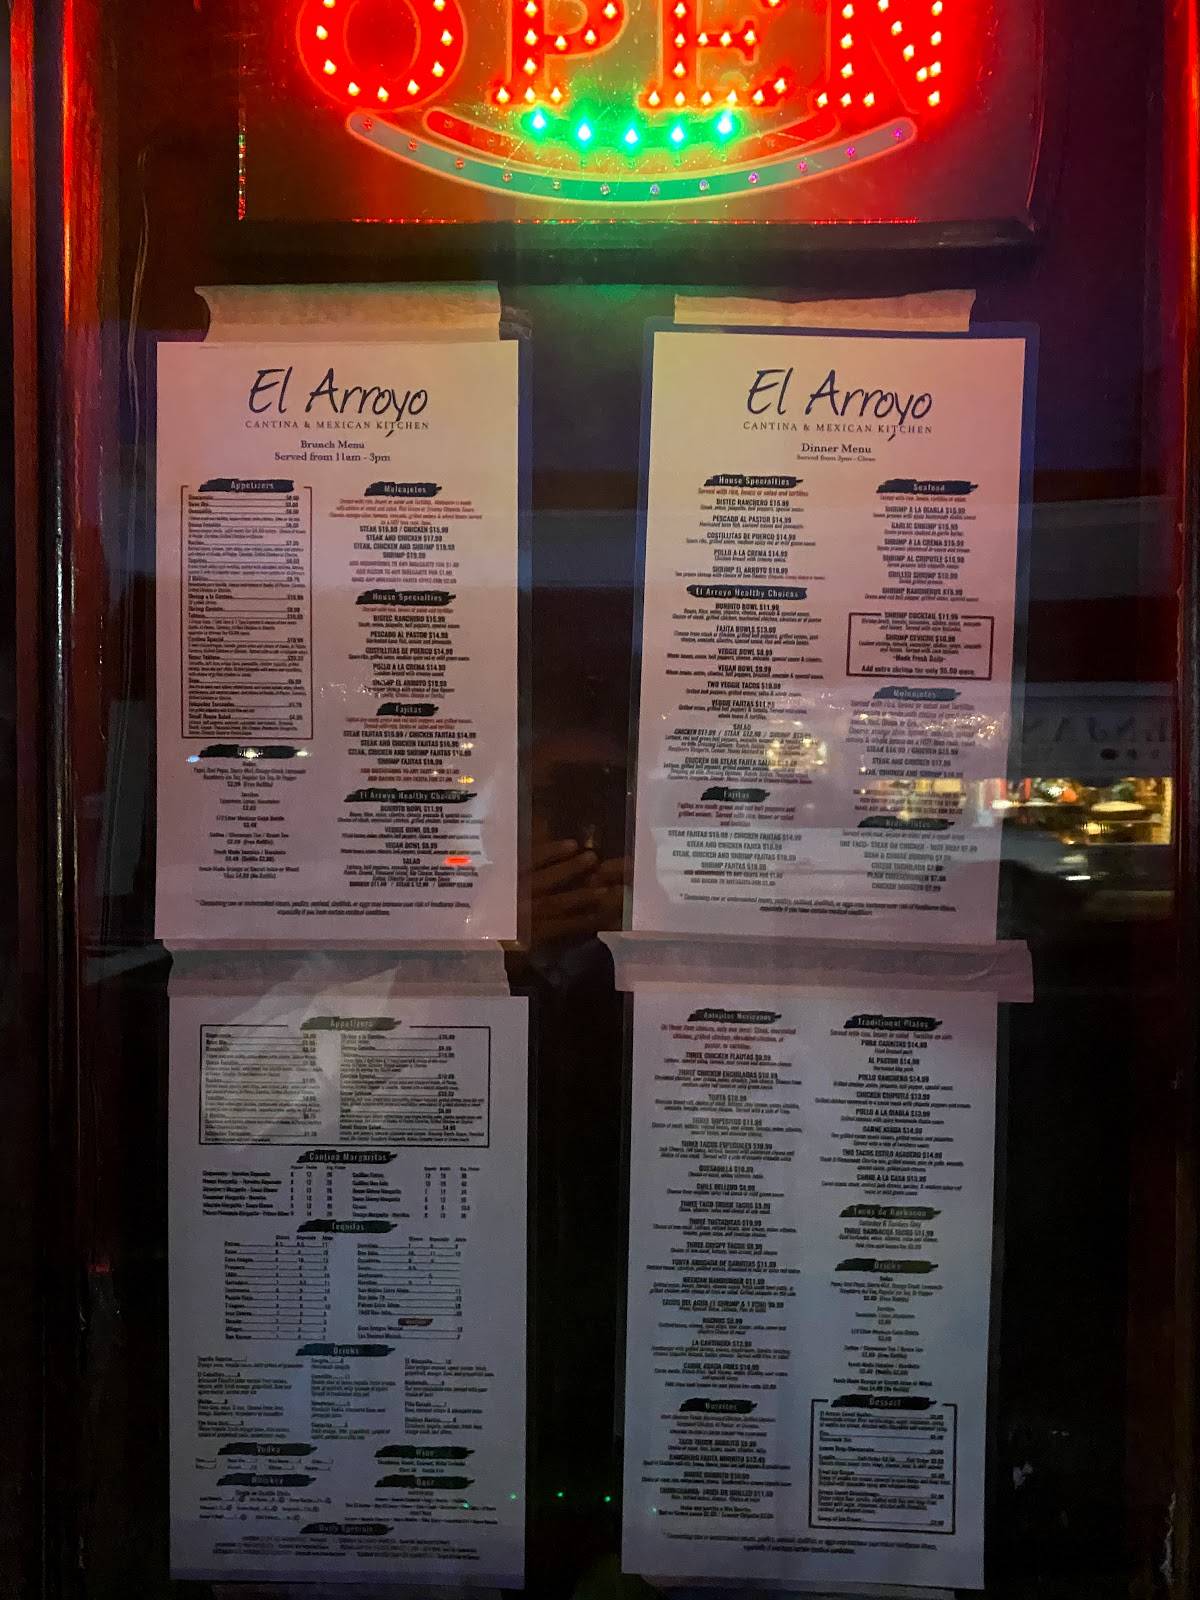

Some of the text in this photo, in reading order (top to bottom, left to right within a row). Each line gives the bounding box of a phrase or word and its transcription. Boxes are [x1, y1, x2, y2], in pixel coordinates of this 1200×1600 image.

[294, 0, 948, 112] OPEN
[249, 367, 428, 437] El Arroyo
[747, 367, 932, 441] El Arroyo
[316, 421, 370, 429] MEXICAN
[377, 421, 429, 429] KITCHEN
[743, 421, 797, 431] CANTINA
[817, 424, 872, 432] MEXICAN
[878, 424, 932, 433] KITCHEN
[300, 440, 365, 449] Brunch Menu
[801, 443, 872, 454] Dinner Menu
[274, 452, 307, 461] Served
[310, 452, 332, 461] from
[336, 452, 361, 461] 11am
[369, 452, 390, 463] 3pm
[746, 478, 789, 486] Specialties
[706, 588, 732, 596] Arroyo
[735, 589, 764, 597] Healthy
